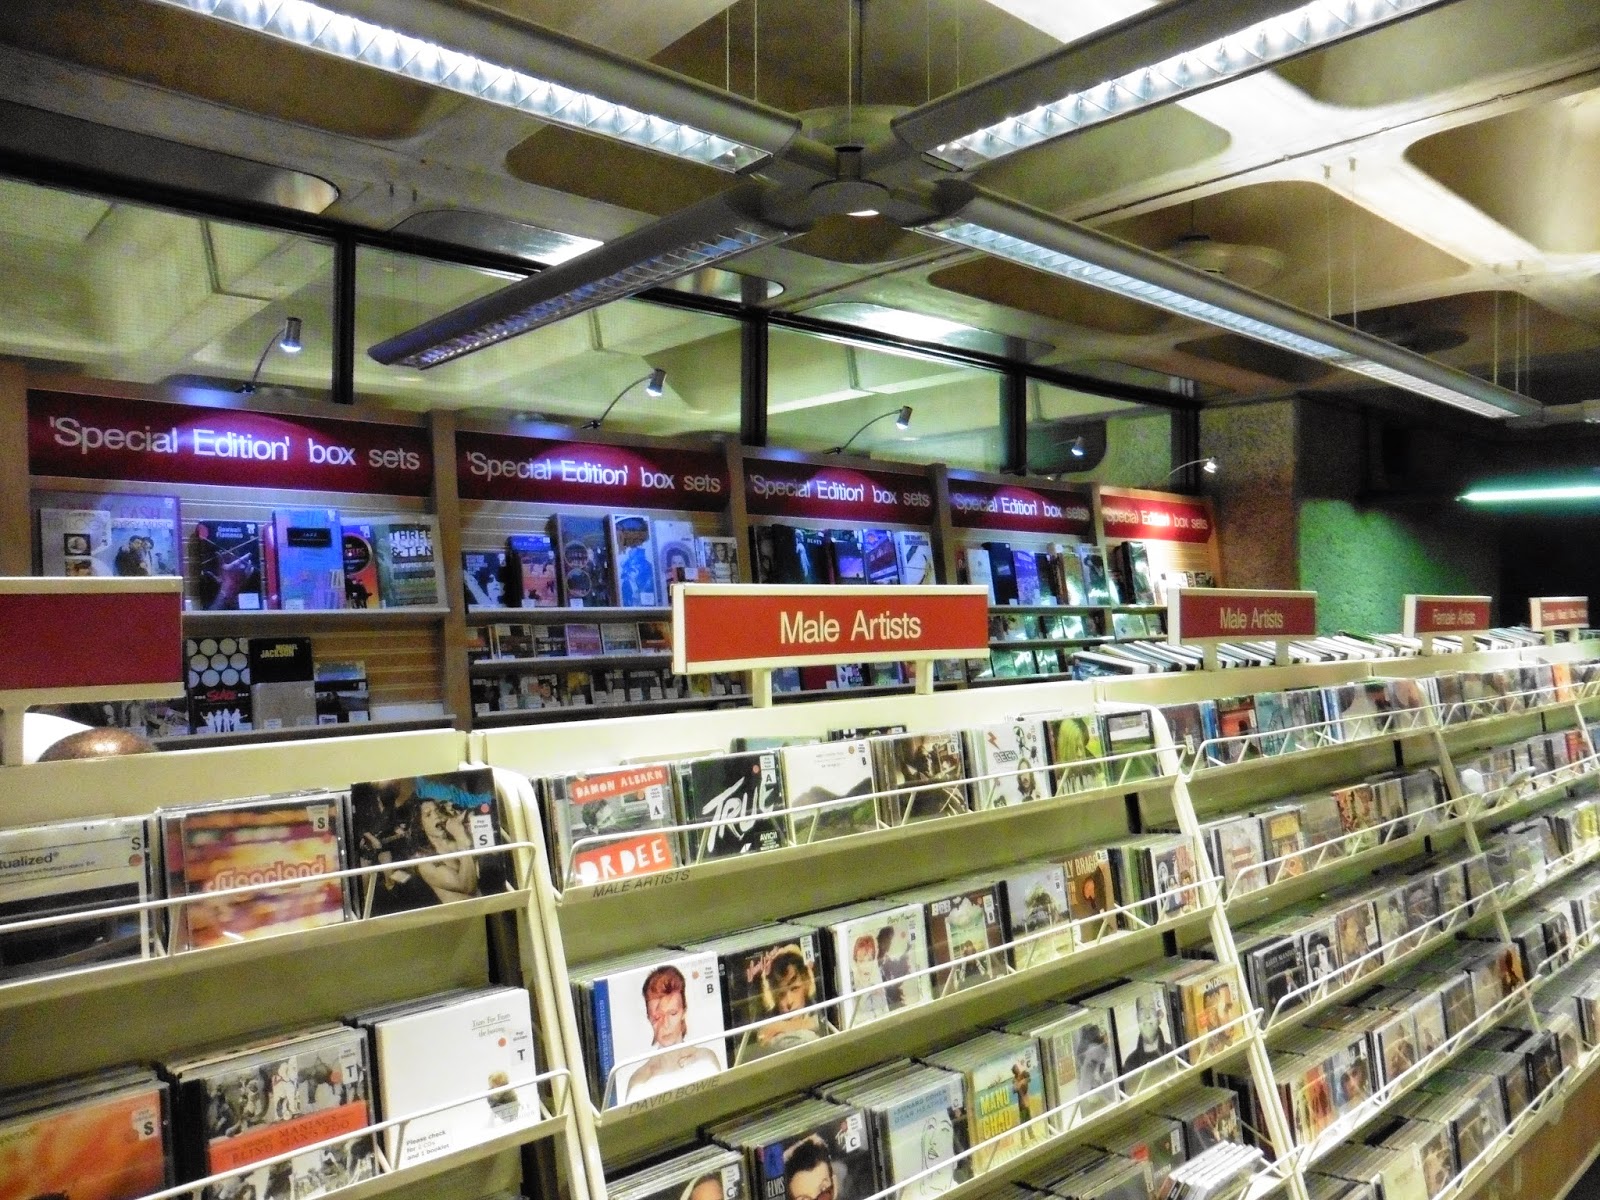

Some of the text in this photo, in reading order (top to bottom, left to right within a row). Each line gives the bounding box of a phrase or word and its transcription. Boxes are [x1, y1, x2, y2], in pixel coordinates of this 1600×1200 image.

[50, 417, 421, 470] 'Special Edition' box sets
[466, 451, 551, 481] 'Special
[641, 467, 675, 490] box
[683, 474, 721, 493] sets
[872, 485, 898, 505] box
[903, 491, 931, 507] sets
[1042, 501, 1062, 518] box
[1065, 506, 1090, 521] sets
[1220, 606, 1284, 629] Male Artists
[1432, 608, 1456, 625] Female
[780, 609, 922, 645] Male Artists
[260, 648, 295, 658] JACKSON
[765, 774, 773, 783] A
[576, 780, 616, 798] DAMON
[317, 817, 326, 830] S
[131, 836, 141, 851] S
[479, 834, 488, 847] S
[619, 838, 667, 874] DEE
[593, 869, 691, 898] MALE ARTISTS
[707, 983, 714, 994] B
[517, 1049, 526, 1061] T
[345, 1065, 355, 1078] T
[629, 1078, 720, 1114] DAVID BOWIE
[143, 1121, 154, 1136] S
[406, 1129, 446, 1146] Please check
[426, 1143, 450, 1154] booklet
